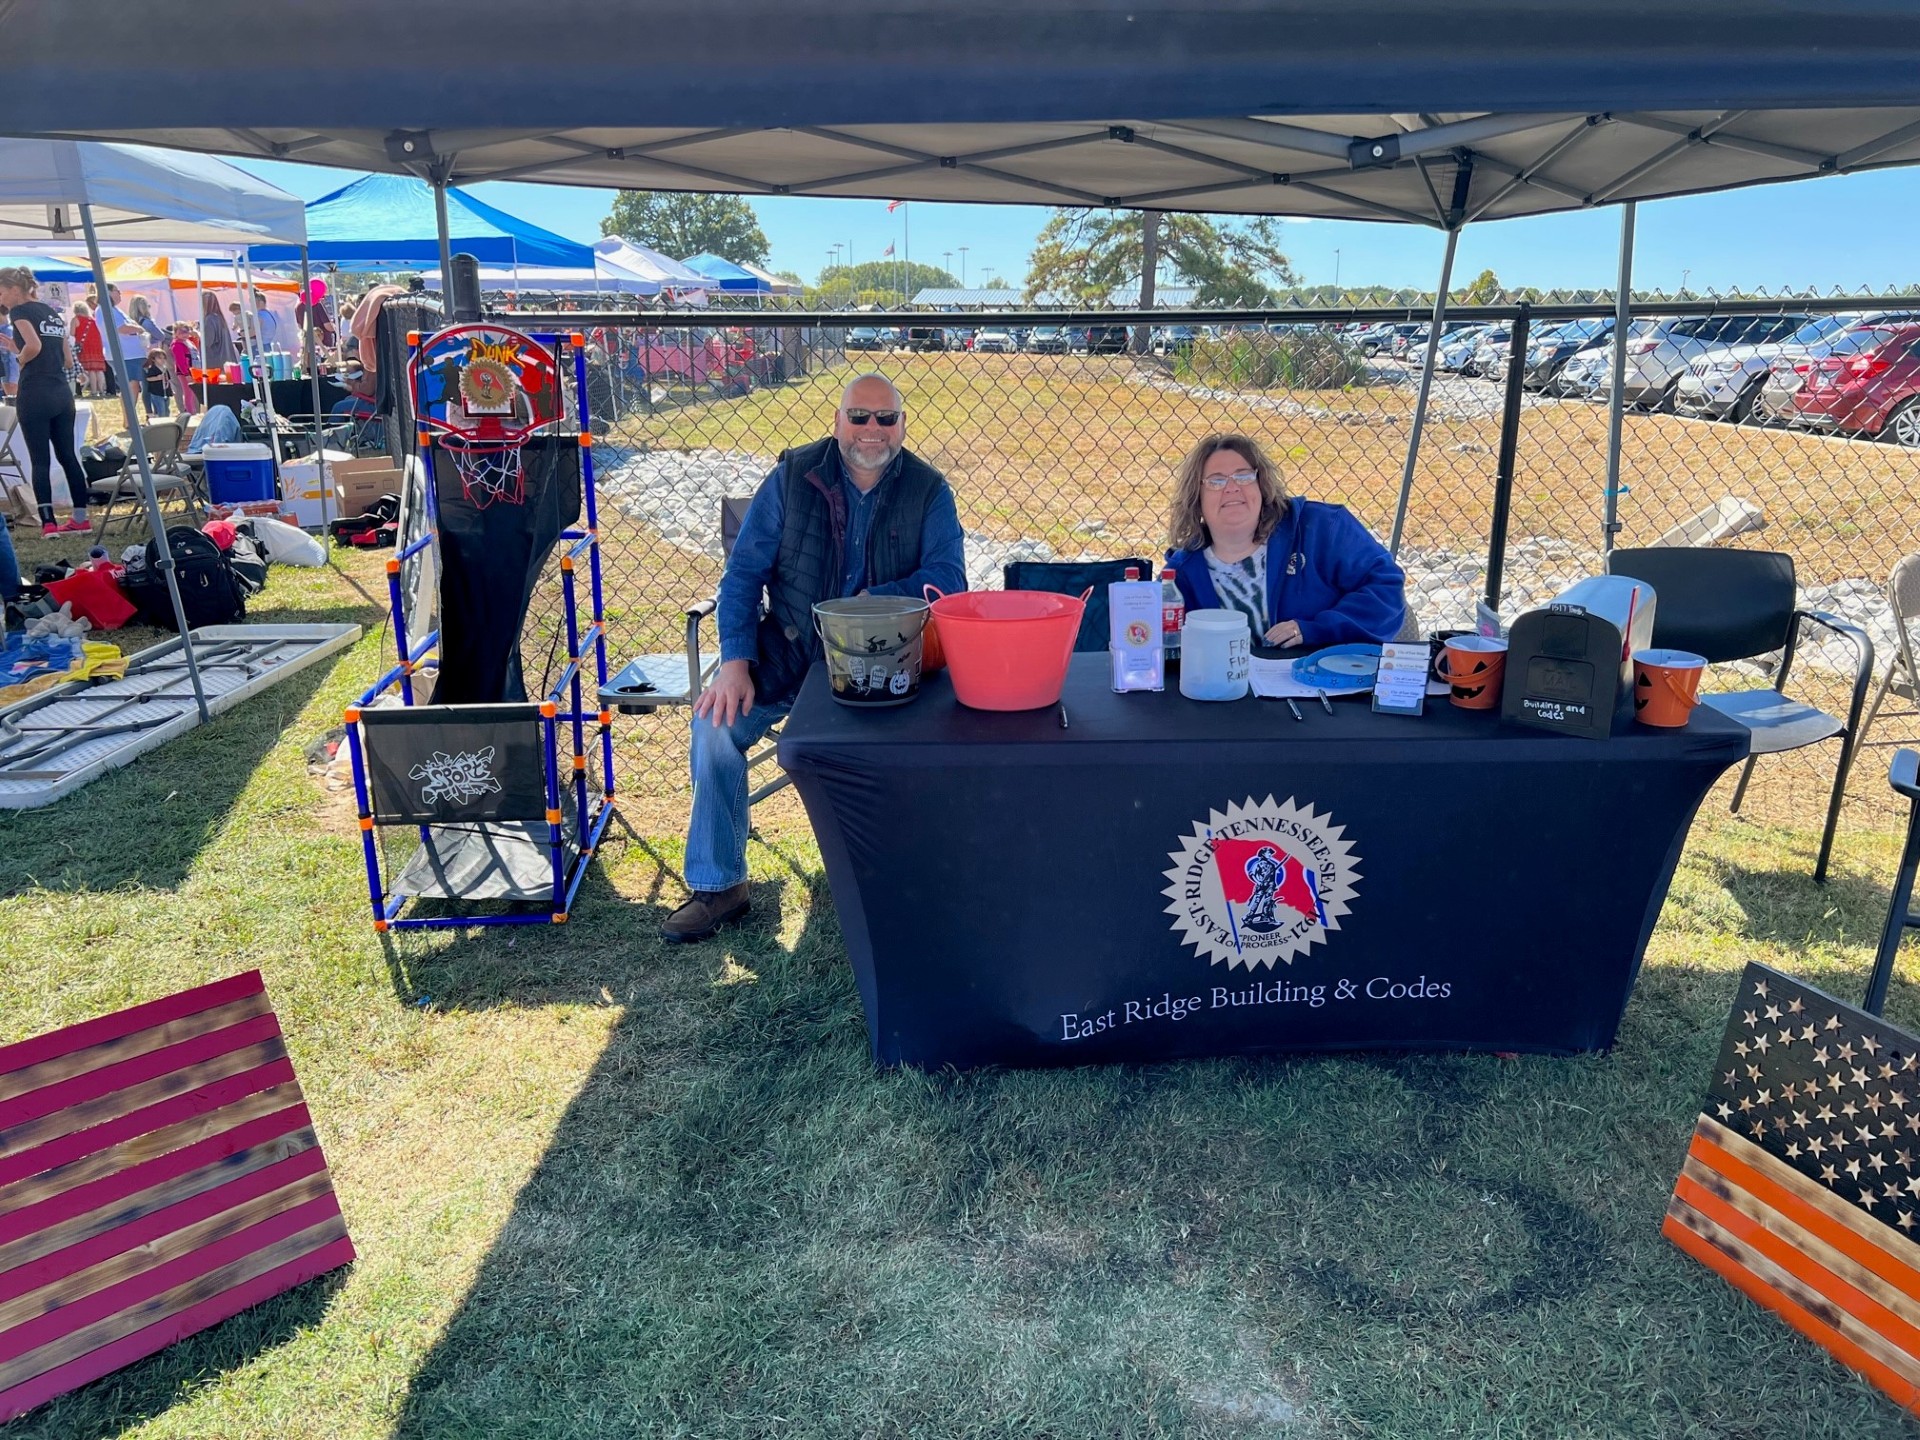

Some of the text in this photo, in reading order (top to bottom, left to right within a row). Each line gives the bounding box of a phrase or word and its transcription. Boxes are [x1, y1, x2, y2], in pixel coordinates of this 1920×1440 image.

[470, 337, 526, 369] DUNK
[1523, 699, 1585, 715] Building and
[1537, 709, 1565, 720] Codes
[1060, 975, 1452, 1041] East Ridge Building & Codes
